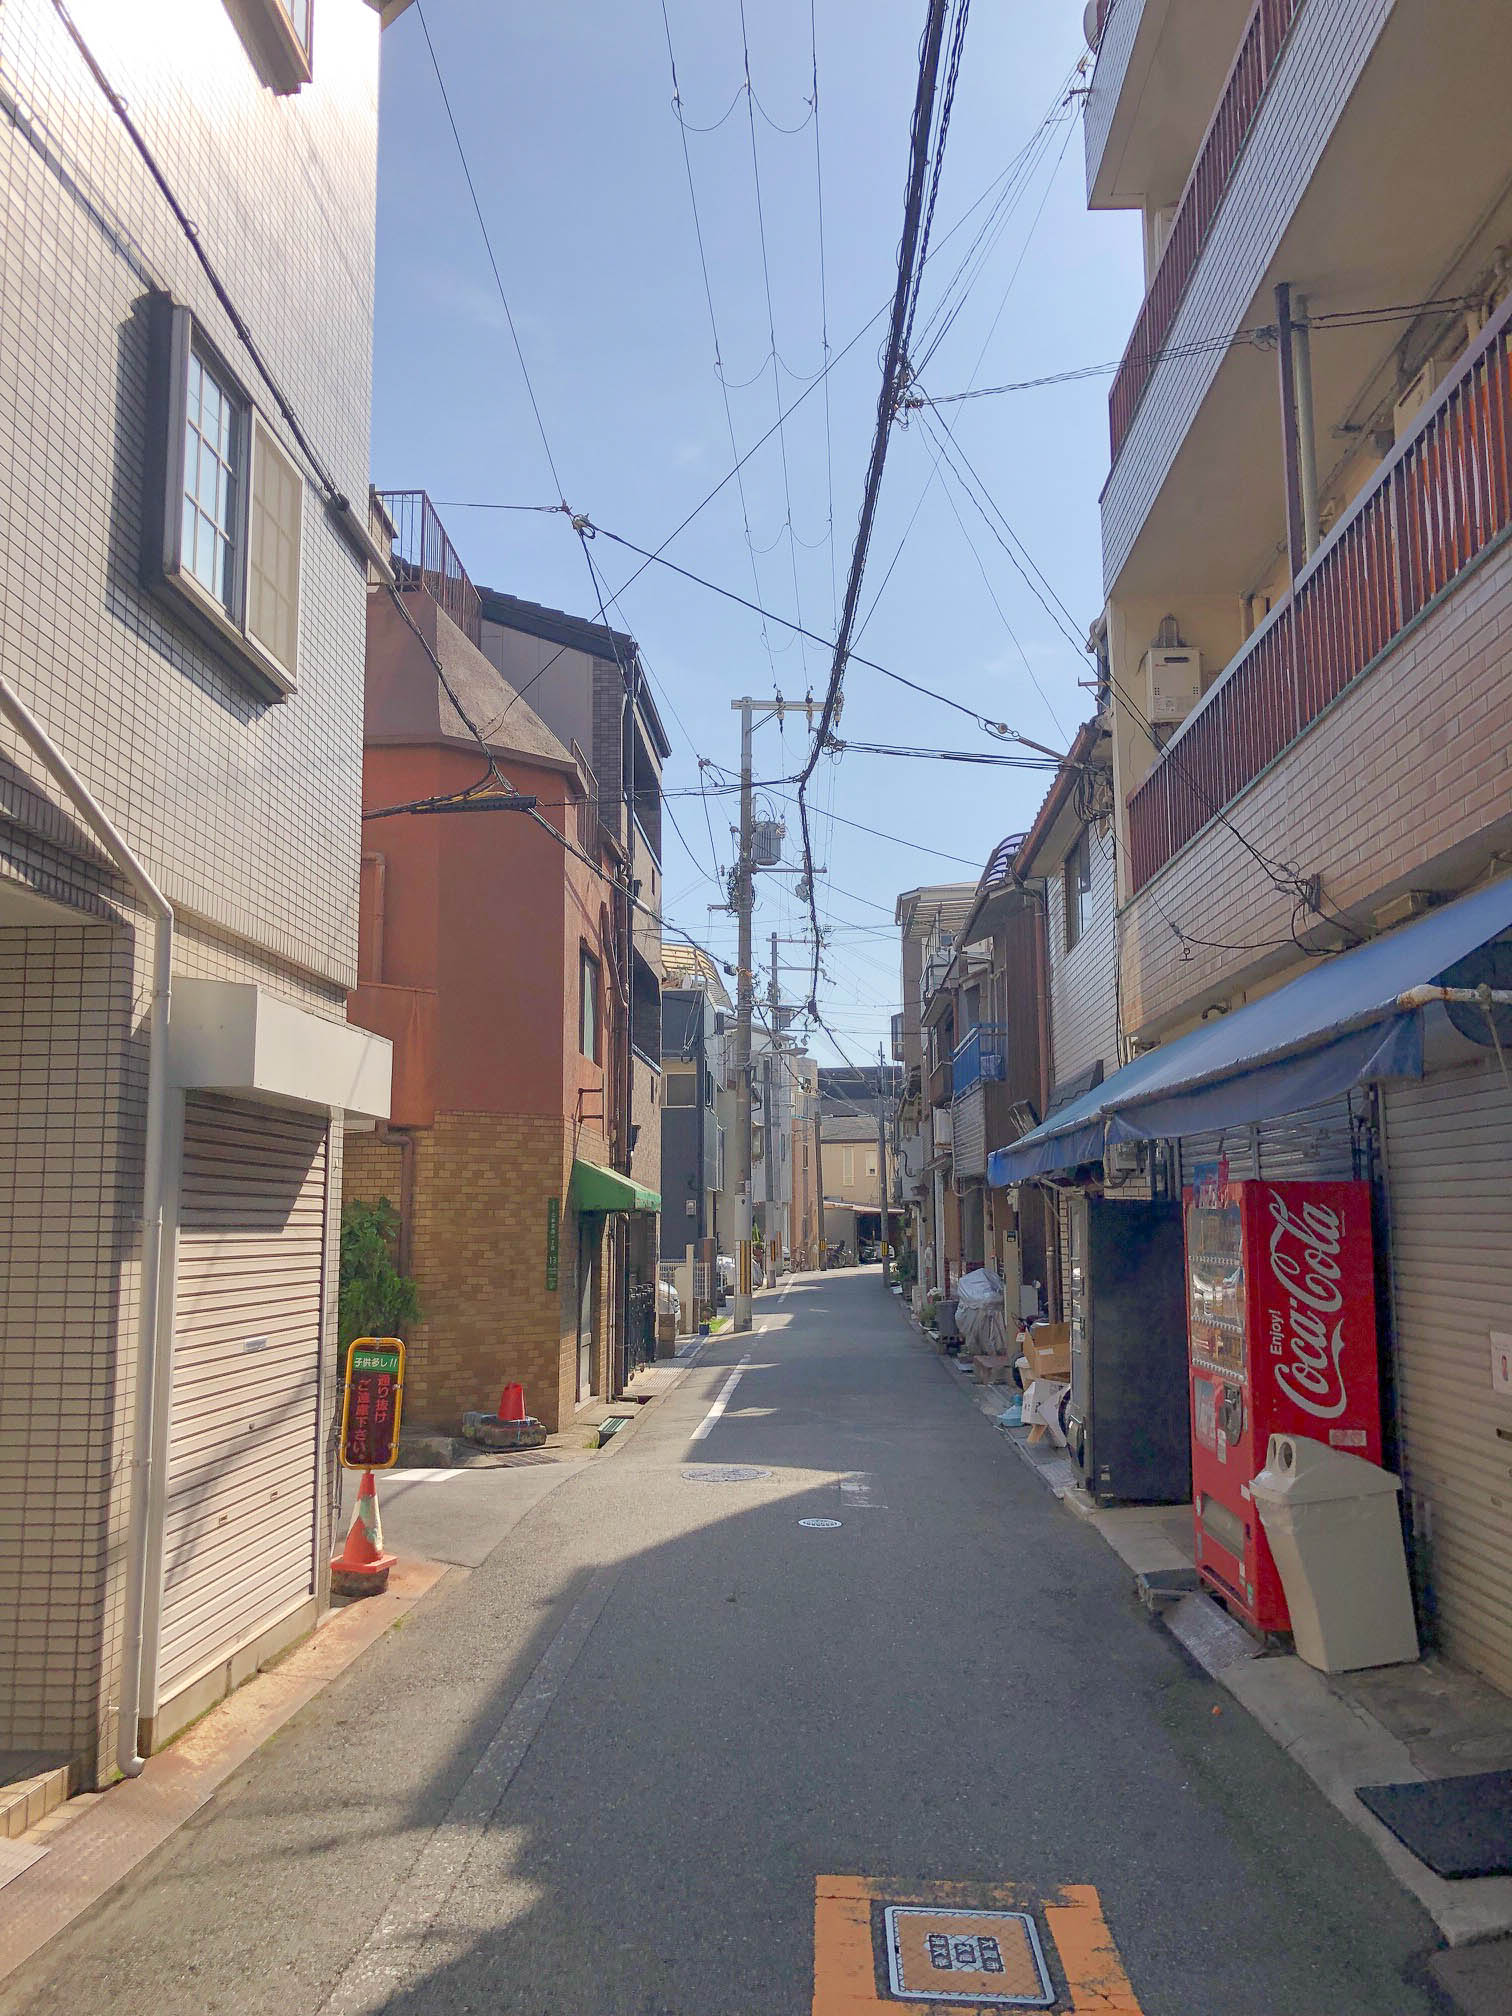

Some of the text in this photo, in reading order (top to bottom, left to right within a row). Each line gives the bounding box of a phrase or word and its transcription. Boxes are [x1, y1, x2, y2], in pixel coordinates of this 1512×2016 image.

[1269, 1188, 1347, 1419] Coca-Cola
[1269, 1309, 1285, 1356] Enjoy!
[375, 1374, 391, 1424] 通り抜け
